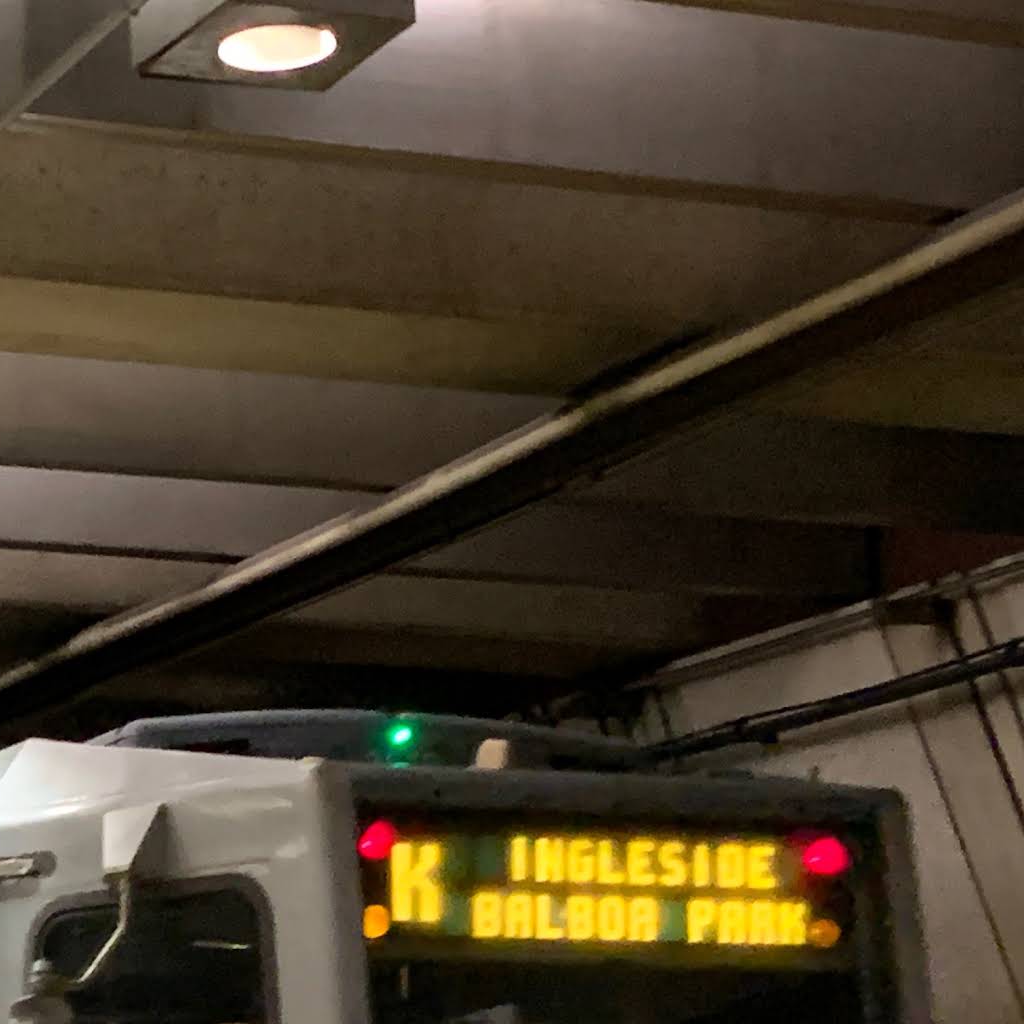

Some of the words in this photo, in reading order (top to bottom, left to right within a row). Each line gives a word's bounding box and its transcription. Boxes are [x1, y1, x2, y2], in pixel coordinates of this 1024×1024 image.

[389, 841, 443, 924] K
[509, 836, 779, 890] INGLESIDE
[470, 890, 660, 942] BALBOA
[686, 896, 810, 945] PARK
